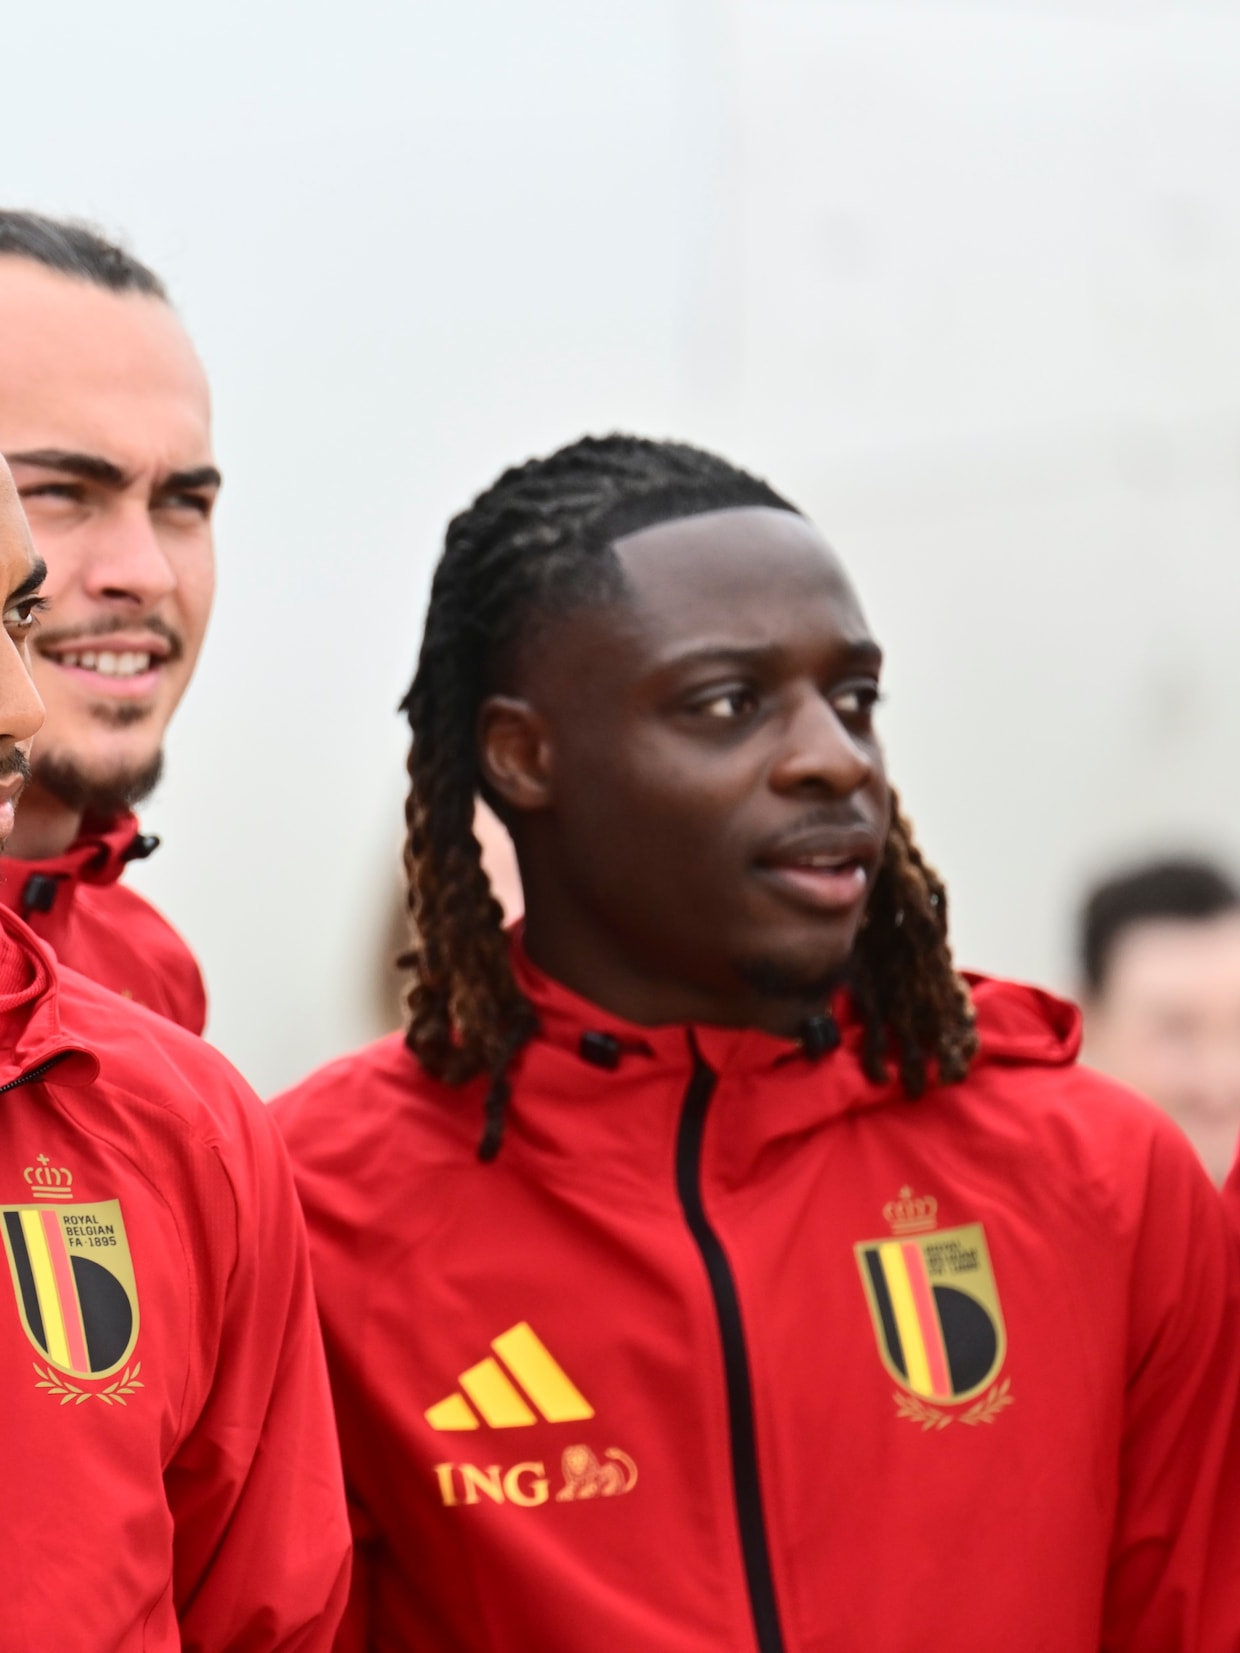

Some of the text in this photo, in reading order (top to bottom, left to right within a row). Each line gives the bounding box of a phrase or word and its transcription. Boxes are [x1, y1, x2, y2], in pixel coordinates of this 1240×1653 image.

[63, 1214, 99, 1225] ROYAL
[66, 1224, 114, 1236] BELGIAN
[433, 1460, 551, 1507] ING
